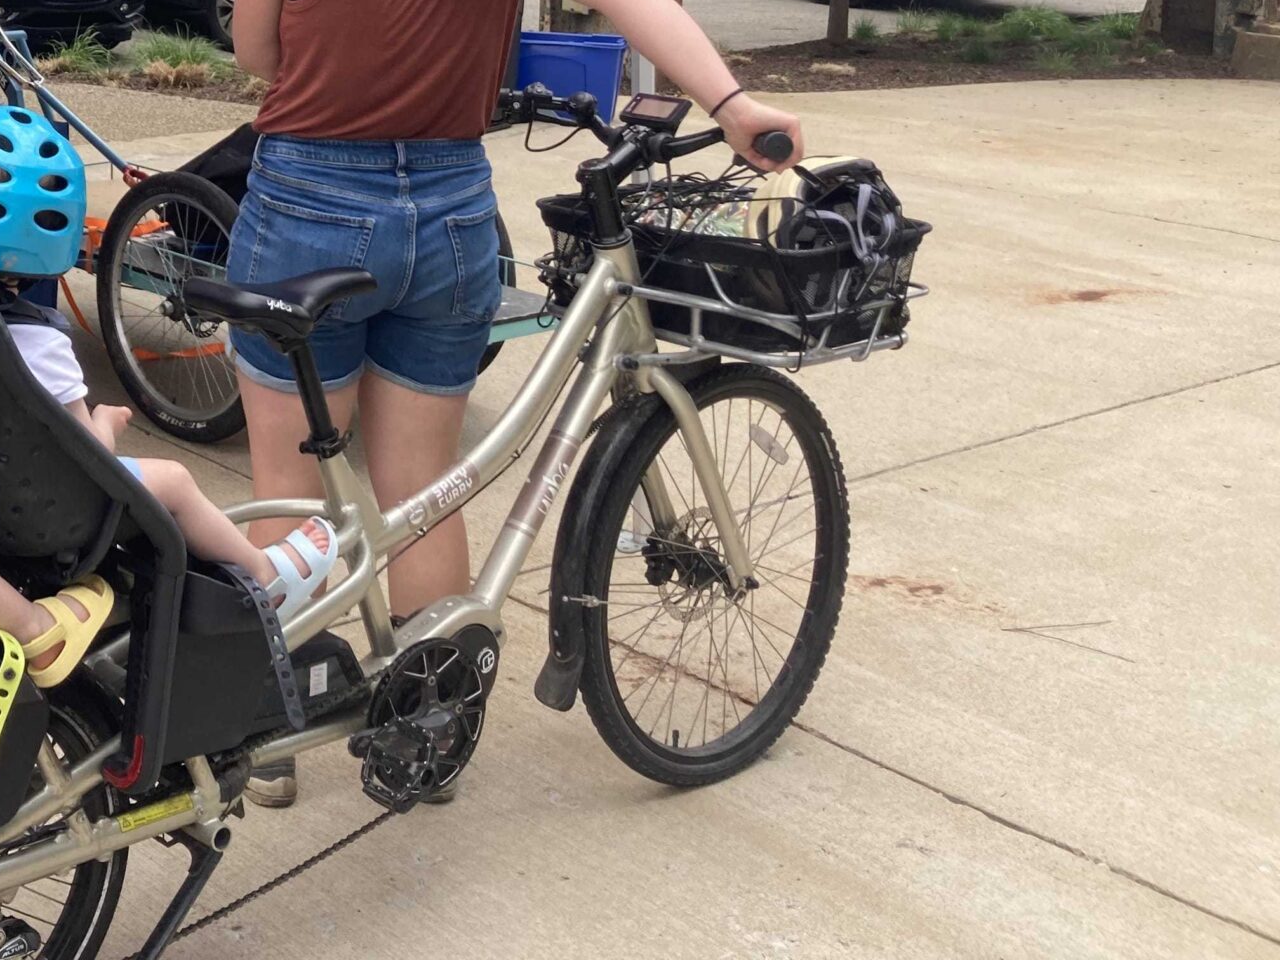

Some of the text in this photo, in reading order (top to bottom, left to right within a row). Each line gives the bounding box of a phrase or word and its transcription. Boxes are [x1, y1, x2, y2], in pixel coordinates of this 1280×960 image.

[266, 299, 293, 313] yuba
[431, 466, 468, 499] SPICY
[438, 477, 473, 509] CURRY
[2, 945, 24, 958] ALTUS
